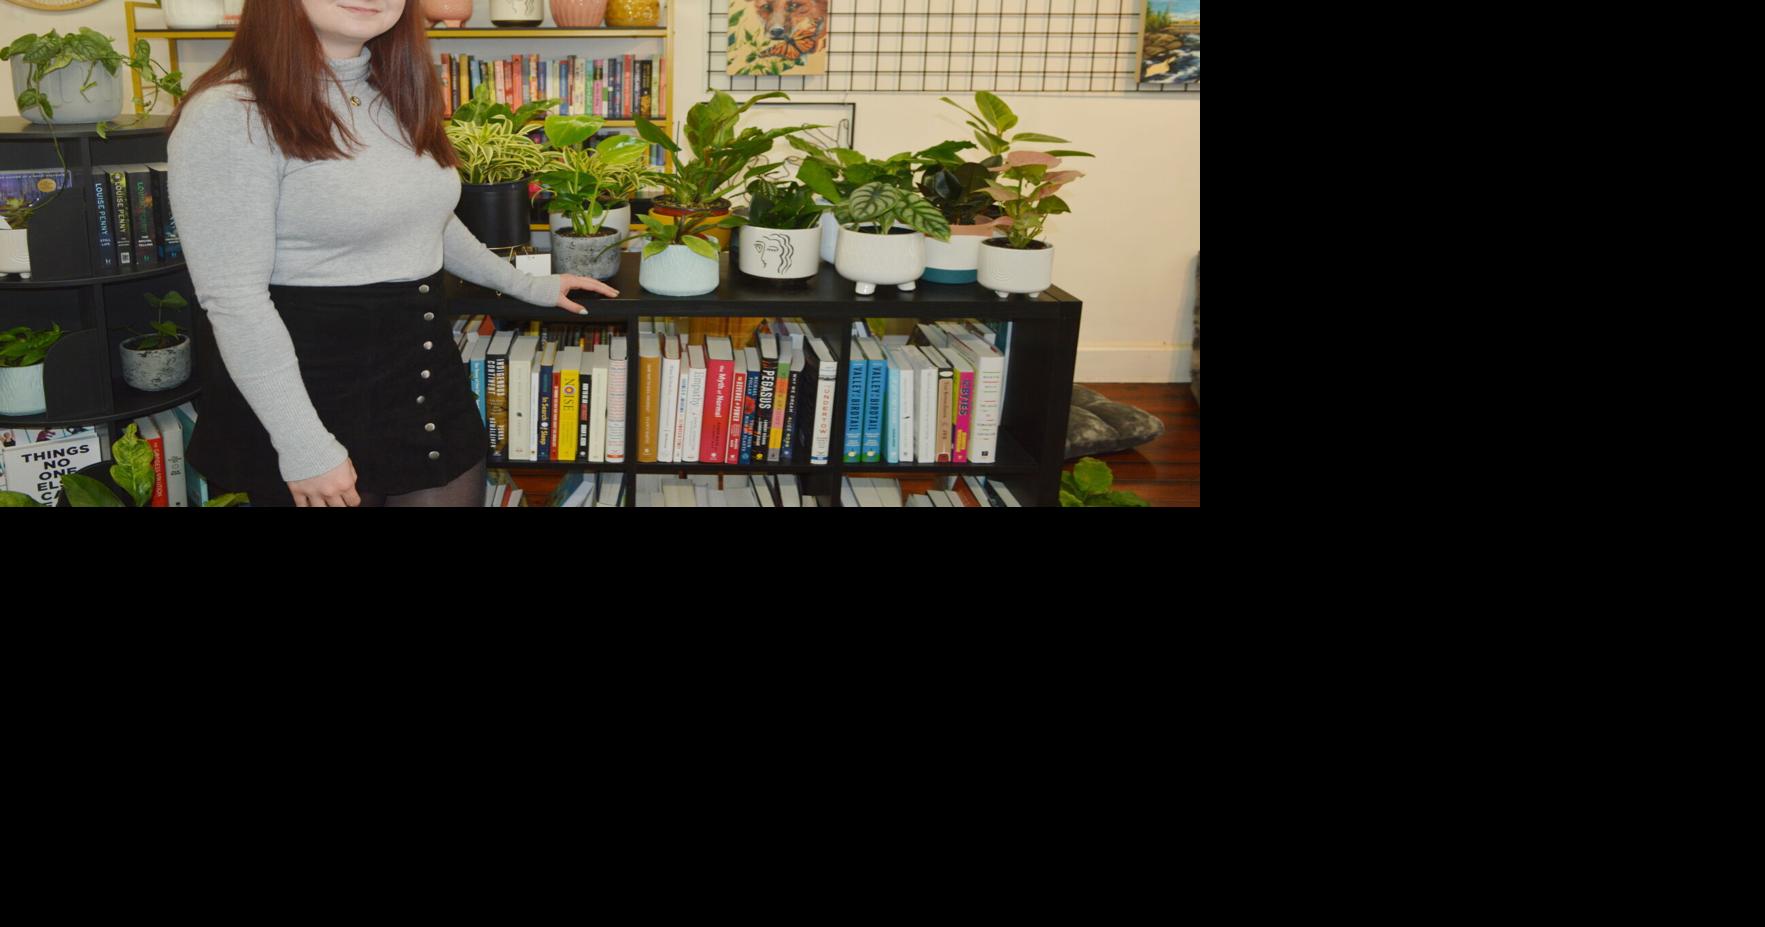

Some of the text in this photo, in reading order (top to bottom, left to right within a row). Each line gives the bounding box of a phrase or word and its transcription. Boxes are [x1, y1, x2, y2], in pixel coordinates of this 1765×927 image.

[115, 182, 124, 208] LOUISE
[95, 183, 108, 235] LOUISE PENNY
[118, 210, 127, 233] PENNY
[487, 360, 496, 395] CONTINENT
[716, 373, 726, 389] Myth
[759, 369, 775, 410] PEGASUS
[852, 367, 862, 393] VALLEY
[871, 367, 881, 393] VALLEY
[563, 378, 576, 411] NOISE
[714, 395, 724, 418] Normal
[849, 399, 860, 431] BIRDTAIL
[868, 399, 880, 431] BIRDTAIL
[21, 445, 90, 463] THINGS
[44, 458, 70, 470] NO
[39, 467, 77, 481] ONE
